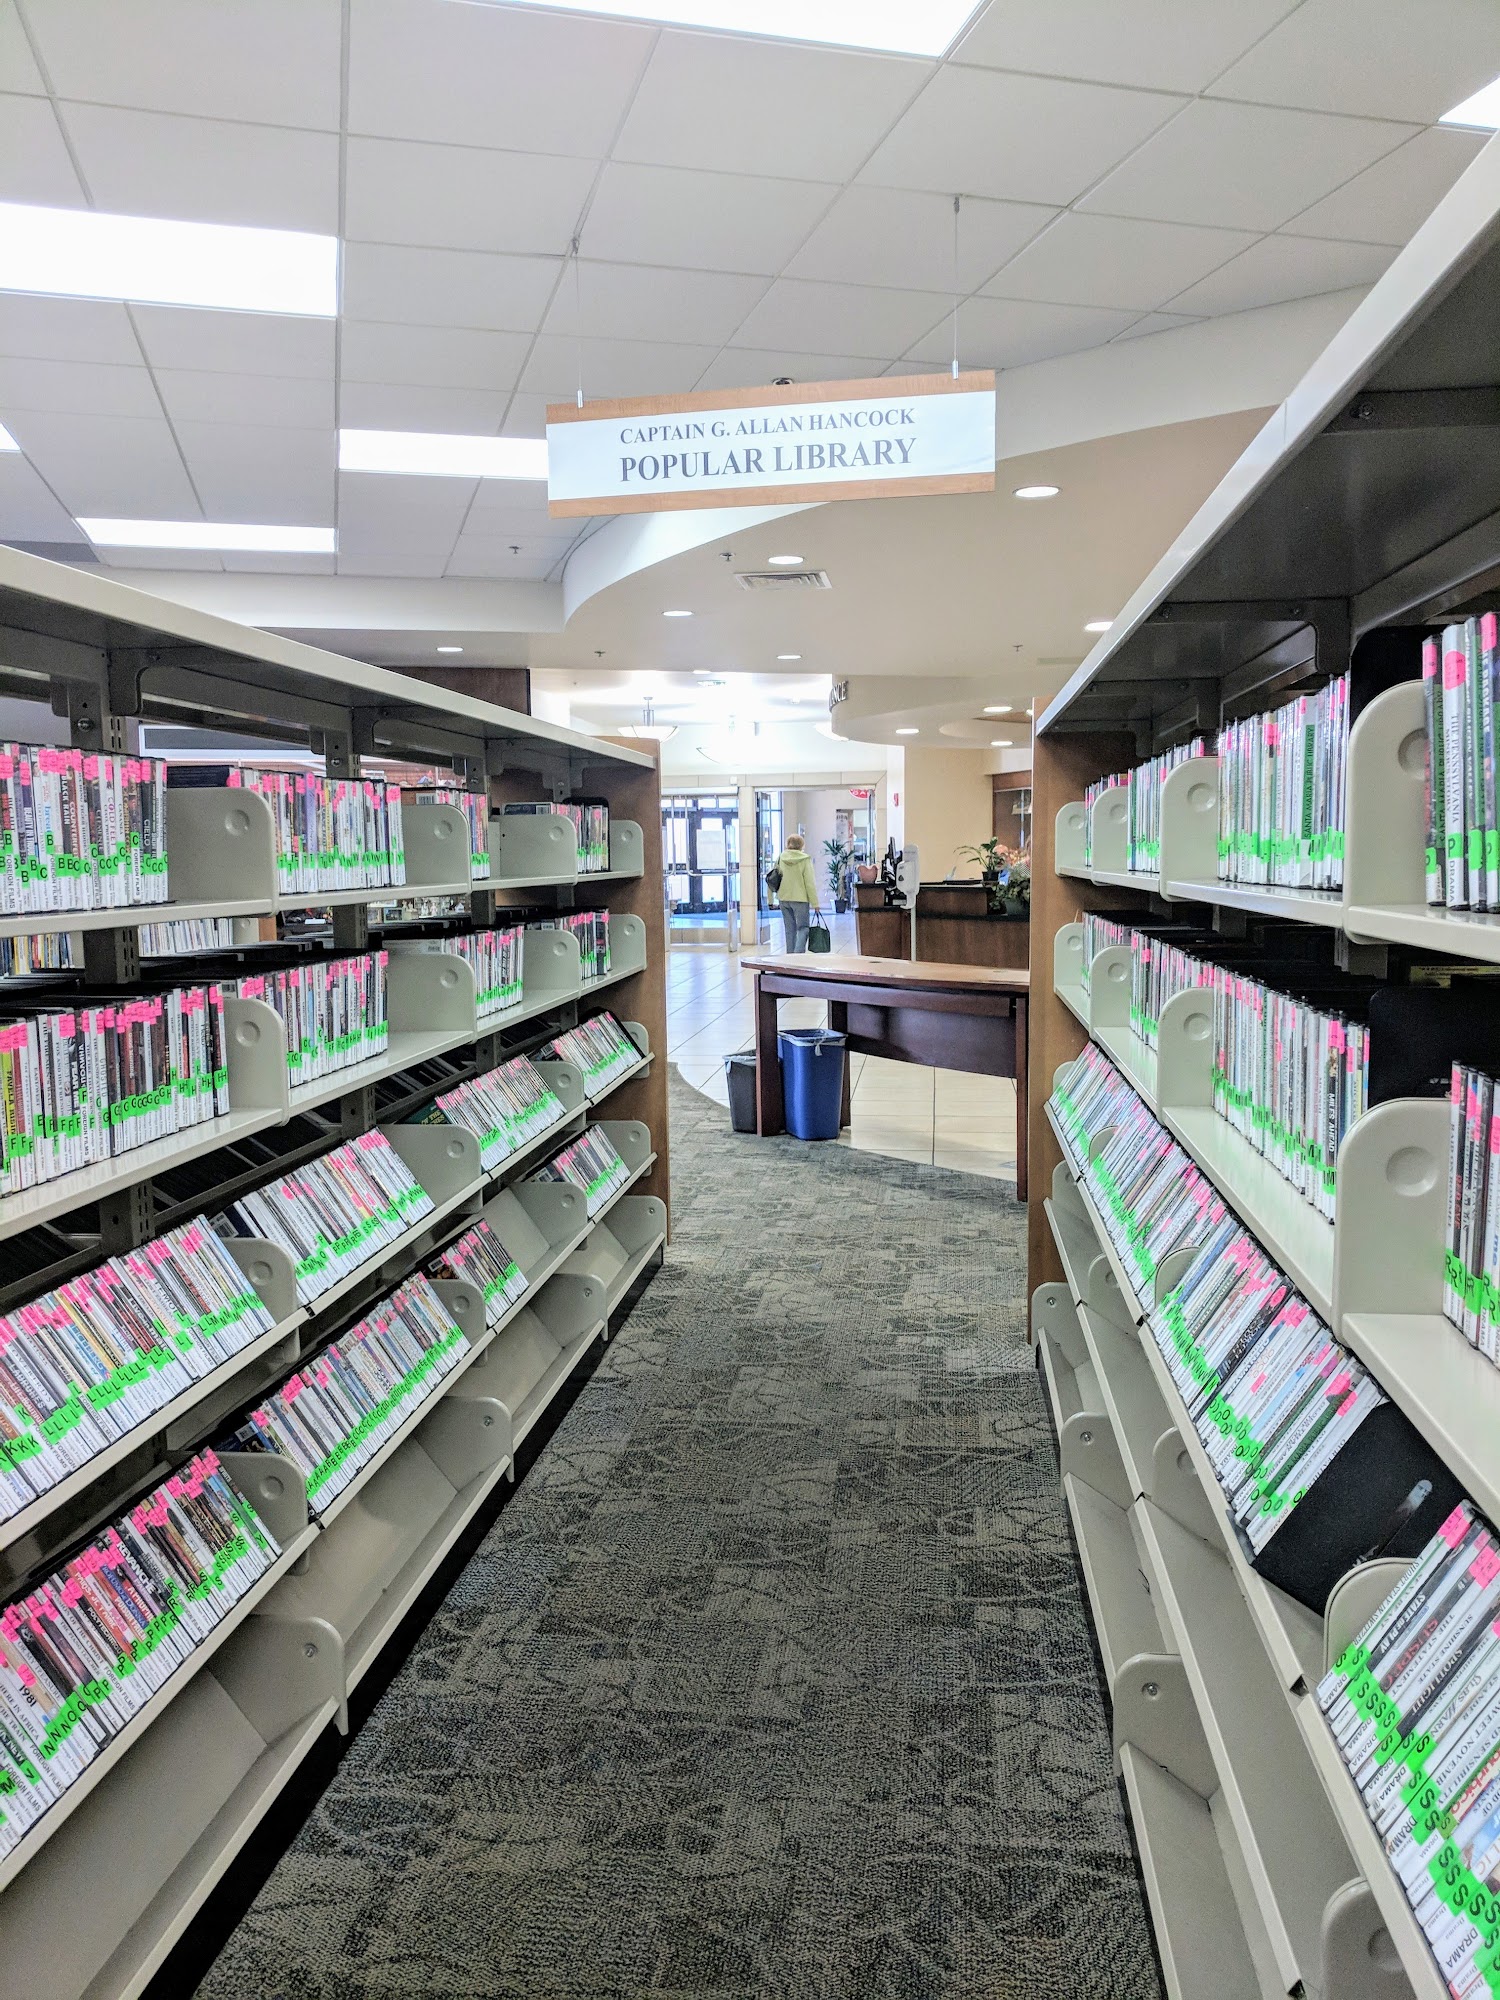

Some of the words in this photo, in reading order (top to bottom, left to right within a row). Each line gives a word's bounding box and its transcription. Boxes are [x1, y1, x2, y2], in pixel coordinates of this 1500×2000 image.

[620, 423, 706, 445] CAPTAIN
[711, 419, 731, 438] G.
[735, 415, 803, 436] ALLAN
[809, 408, 916, 431] HANCOCK
[620, 446, 764, 483] POPULAR
[774, 437, 918, 472] LIBRARY
[1451, 714, 1459, 732] THE
[61, 775, 70, 802] BLACK
[1437, 772, 1445, 803] MARIA
[1451, 737, 1461, 823] PENNSYLVANIA
[25, 807, 36, 828] BEAUTY
[63, 805, 71, 825] RAIN
[1438, 806, 1446, 842] SANTA
[1448, 861, 1456, 903] DRAMA
[7, 1071, 15, 1105] FAVELA
[70, 1062, 80, 1090] FEAR
[1328, 1093, 1336, 1119] MILES
[1328, 1123, 1336, 1152] AHEAD
[1478, 1308, 1487, 1346] DRAMA
[186, 1327, 203, 1349] FOREIGN
[201, 1349, 215, 1366] FILMS
[8, 1363, 45, 1410] LADRONES
[1226, 1366, 1249, 1396] WATER
[79, 1394, 101, 1421] FOREIGN
[99, 1420, 114, 1439] FILMS
[32, 1423, 52, 1448] FOREIGN
[50, 1448, 68, 1469] FILMS
[54, 1442, 77, 1470] FOREIGN
[1219, 1443, 1238, 1467] DRAMA
[115, 1541, 157, 1595] REVANCHE
[1398, 1559, 1421, 1586] SHORT
[114, 1596, 135, 1623] POISON
[1375, 1603, 1387, 1615] IN
[1383, 1585, 1401, 1604] STAY
[1402, 1591, 1427, 1621] STATE
[175, 1596, 194, 1620] FOREIGN
[191, 1619, 205, 1636] FILMS
[1395, 1618, 1406, 1630] OF
[1436, 1613, 1455, 1636] THE
[69, 1617, 78, 1627] OF
[75, 1626, 87, 1640] THE
[85, 1640, 104, 1665] CHRIST
[1377, 1627, 1399, 1654] PLAY
[1438, 1613, 1474, 1656] SUNSHINE
[1389, 1634, 1438, 1698] STATEMENT
[1416, 1656, 1440, 1684] STATE
[18, 1684, 38, 1708] 1981
[102, 1666, 124, 1694] FOREIGN
[120, 1692, 136, 1711] FILMS
[1323, 1674, 1347, 1706] DRAMA
[1408, 1647, 1464, 1717] SPOTLIGHT
[1461, 1675, 1499, 1721] STANDER
[13, 1704, 22, 1715] IN
[19, 1713, 41, 1741] AFRICA
[1350, 1733, 1378, 1767] DRAMA
[28, 1744, 52, 1774] FOREIGN
[48, 1772, 65, 1793] FILMS
[1366, 1758, 1394, 1790] DRAMA
[1377, 1765, 1409, 1802] DRAMA
[1435, 1739, 1492, 1807] SENSIBILITY
[4, 1763, 29, 1796] FOREIGN
[24, 1792, 42, 1813] FILMS
[1420, 1789, 1434, 1809] S
[1386, 1814, 1419, 1853] DRAMA
[1425, 1810, 1440, 1831] S
[1441, 1815, 1450, 1831] S
[1418, 1834, 1439, 1859] DRAMA
[1439, 1847, 1454, 1868] S
[1446, 1864, 1460, 1885] S
[1453, 1884, 1468, 1906] S
[1470, 1893, 1486, 1916] S
[1485, 1901, 1500, 1923] S
[1446, 1928, 1479, 1968] DRAMA
